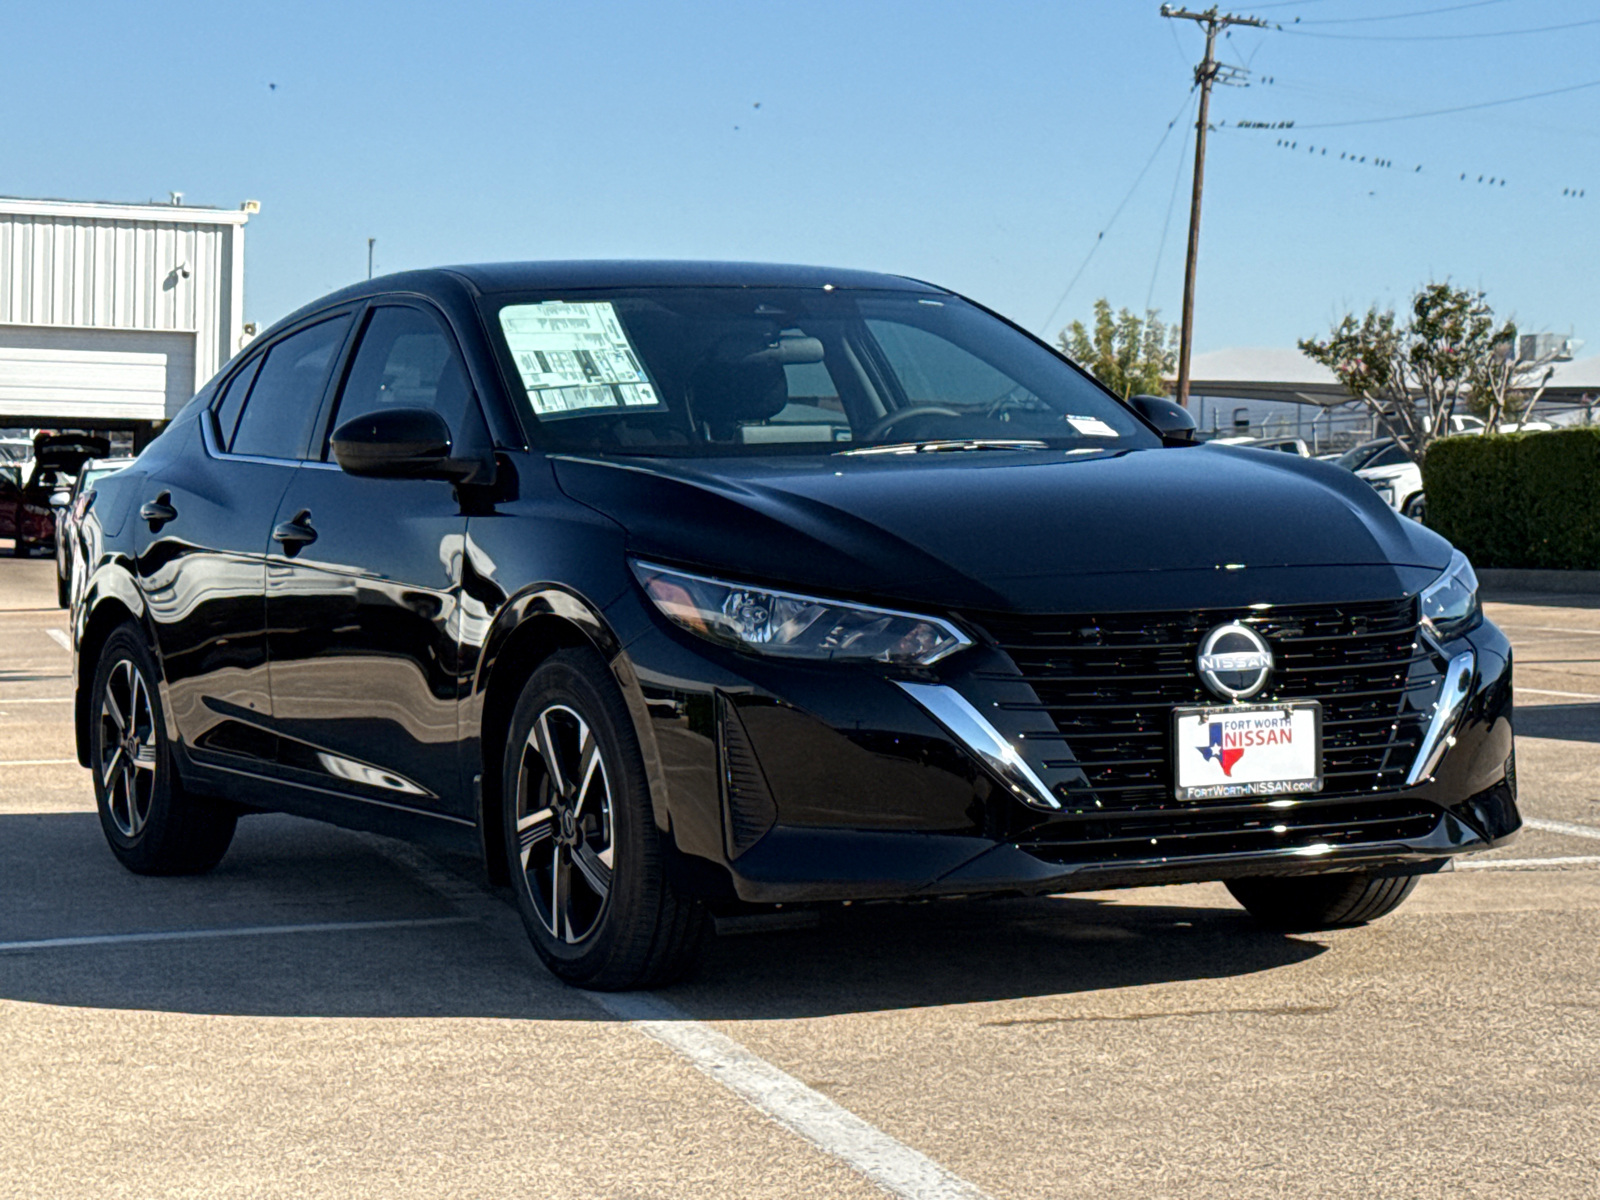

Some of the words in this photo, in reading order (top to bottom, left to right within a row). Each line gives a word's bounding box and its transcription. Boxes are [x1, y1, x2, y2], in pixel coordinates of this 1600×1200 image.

[1201, 655, 1271, 669] NISSAN
[1224, 720, 1251, 730] FORT
[1254, 717, 1292, 729] WORTH
[1225, 728, 1292, 747] NISSAN
